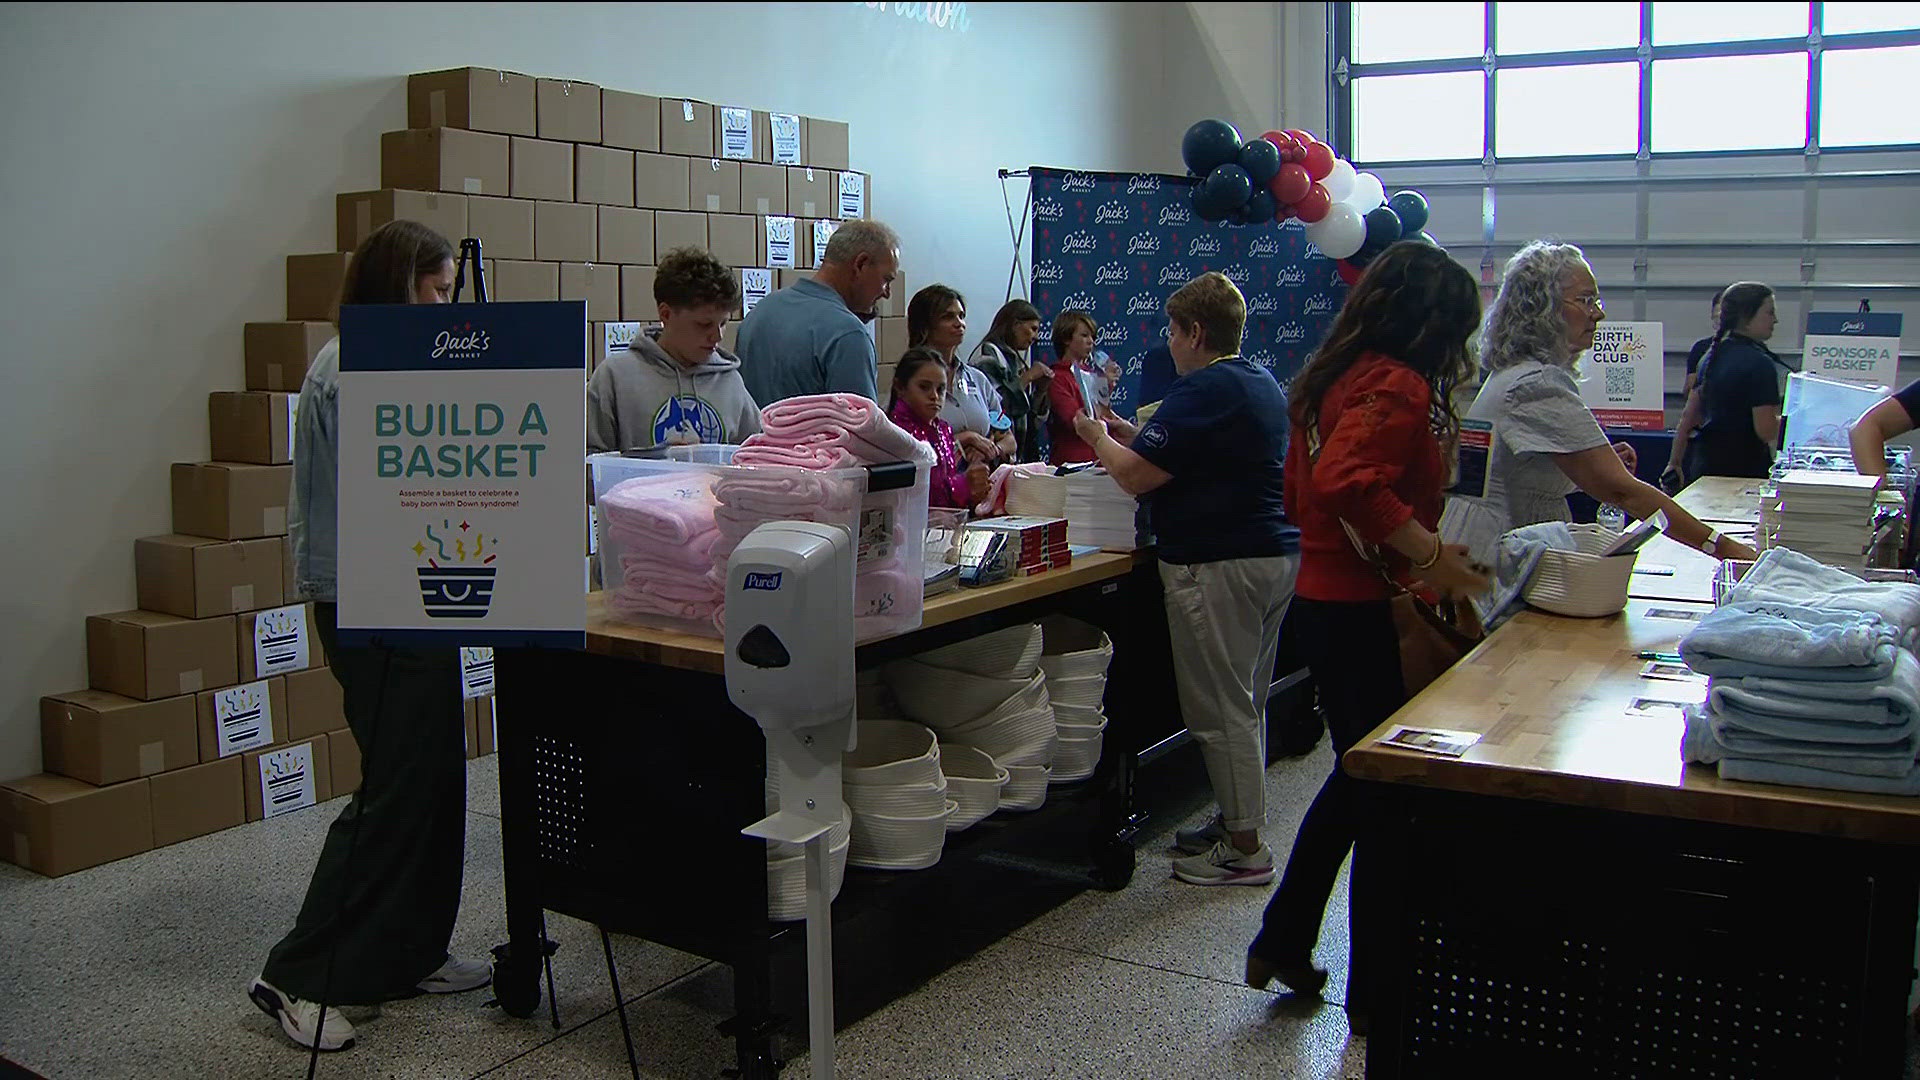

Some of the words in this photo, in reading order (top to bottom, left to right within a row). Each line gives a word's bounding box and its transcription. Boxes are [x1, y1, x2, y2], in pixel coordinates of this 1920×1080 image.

[1061, 172, 1096, 191] Jack's
[1127, 175, 1161, 194] Jack's
[1095, 204, 1129, 224] Jack's
[1158, 206, 1190, 225] Jack's
[1062, 234, 1096, 253] Jack's
[1127, 236, 1160, 255] Jack's
[1188, 238, 1221, 256] Jack's
[1248, 239, 1279, 257] Jack's
[1095, 266, 1129, 285] Jack's
[1158, 267, 1191, 285] Jack's
[1276, 269, 1305, 287] Jack's
[1061, 296, 1096, 312] Jack's
[1127, 297, 1160, 315] Jack's
[1248, 297, 1278, 315] Jack's
[1303, 297, 1332, 315] Jack's
[1095, 326, 1128, 345] Jack's
[1275, 325, 1305, 343] Jack's
[1594, 332, 1633, 341] BIRTH
[431, 330, 490, 359] Jack's
[1594, 343, 1620, 352] DAY
[1811, 346, 1876, 359] SPONSOR
[1879, 349, 1890, 359] A
[1593, 354, 1629, 363] CLUB
[1823, 359, 1875, 371] BASKET
[375, 403, 504, 437] BUILD
[518, 402, 548, 436] A
[377, 444, 546, 478] BASKET
[478, 489, 512, 497] celebrate
[401, 501, 419, 509] baby
[480, 500, 519, 509] syndrome!
[748, 574, 778, 588] Purell
